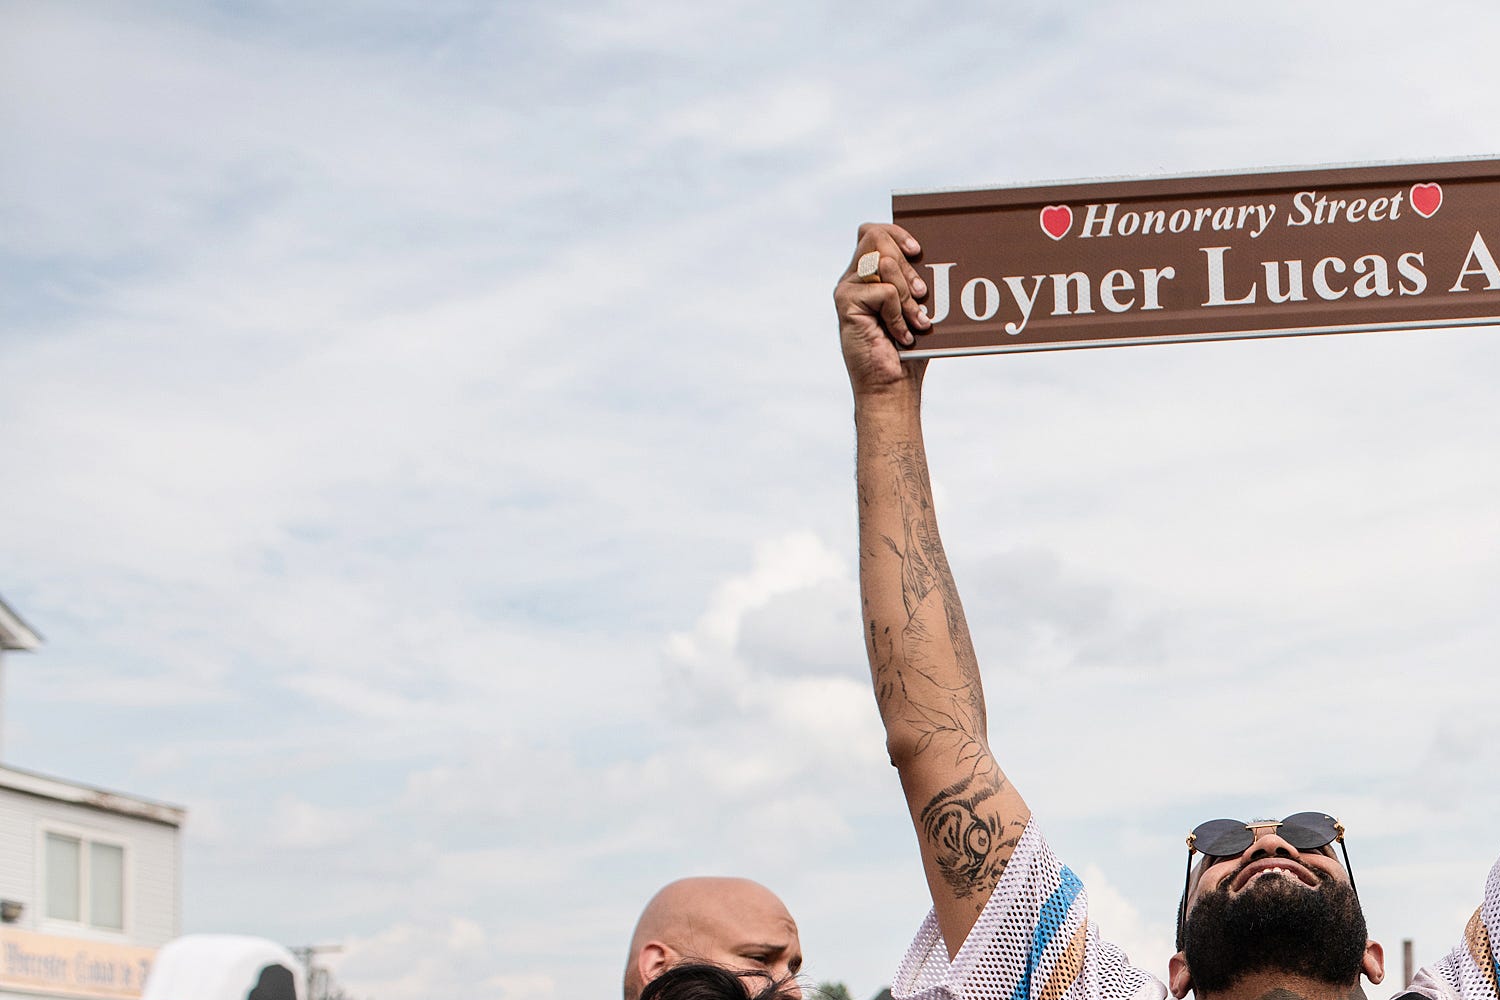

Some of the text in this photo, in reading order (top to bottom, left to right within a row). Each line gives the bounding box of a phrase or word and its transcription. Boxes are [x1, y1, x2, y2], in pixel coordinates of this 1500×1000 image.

[1078, 190, 1403, 238] Honorary Street
[918, 262, 1176, 335] Joyner
[1199, 246, 1428, 306] Lucas
